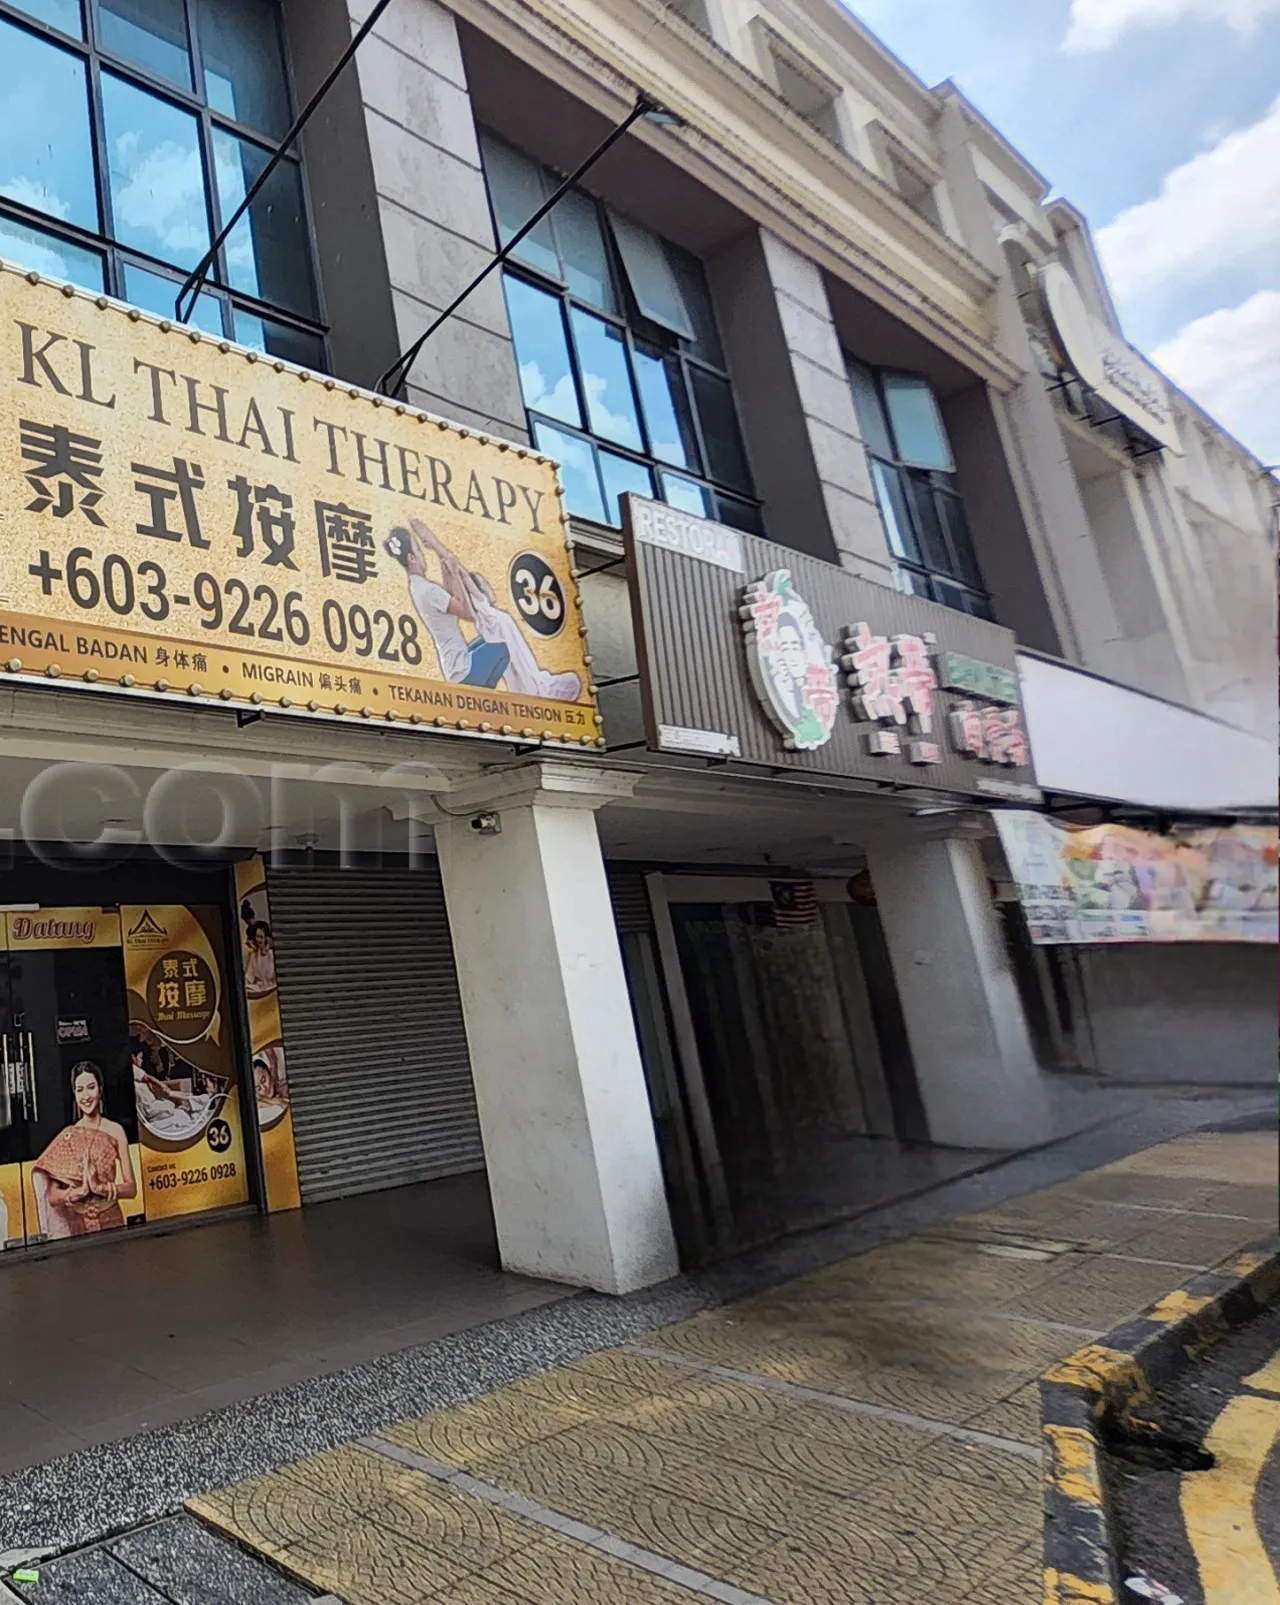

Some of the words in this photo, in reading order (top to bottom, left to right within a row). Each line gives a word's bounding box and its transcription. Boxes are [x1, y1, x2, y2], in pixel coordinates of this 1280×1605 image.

[13, 320, 117, 410] KL
[132, 356, 301, 464] THAI
[312, 415, 546, 534] THERAPY
[19, 419, 379, 585] 泰式按摩
[28, 545, 310, 647] +603-9226
[323, 597, 422, 666] 0928
[516, 568, 563, 622] 36
[76, 635, 148, 665] BADAN
[155, 645, 208, 673] 身体痛
[241, 661, 314, 688] MIGRAIN
[318, 671, 362, 697] 偏头痛
[389, 685, 453, 710] TEKANAN
[456, 695, 509, 717] DENGAN
[511, 702, 562, 723] TENSION
[12, 917, 95, 943] Datang
[209, 1125, 229, 1146] 36
[149, 1167, 208, 1191] +603-9226
[210, 1162, 236, 1181] 0928
